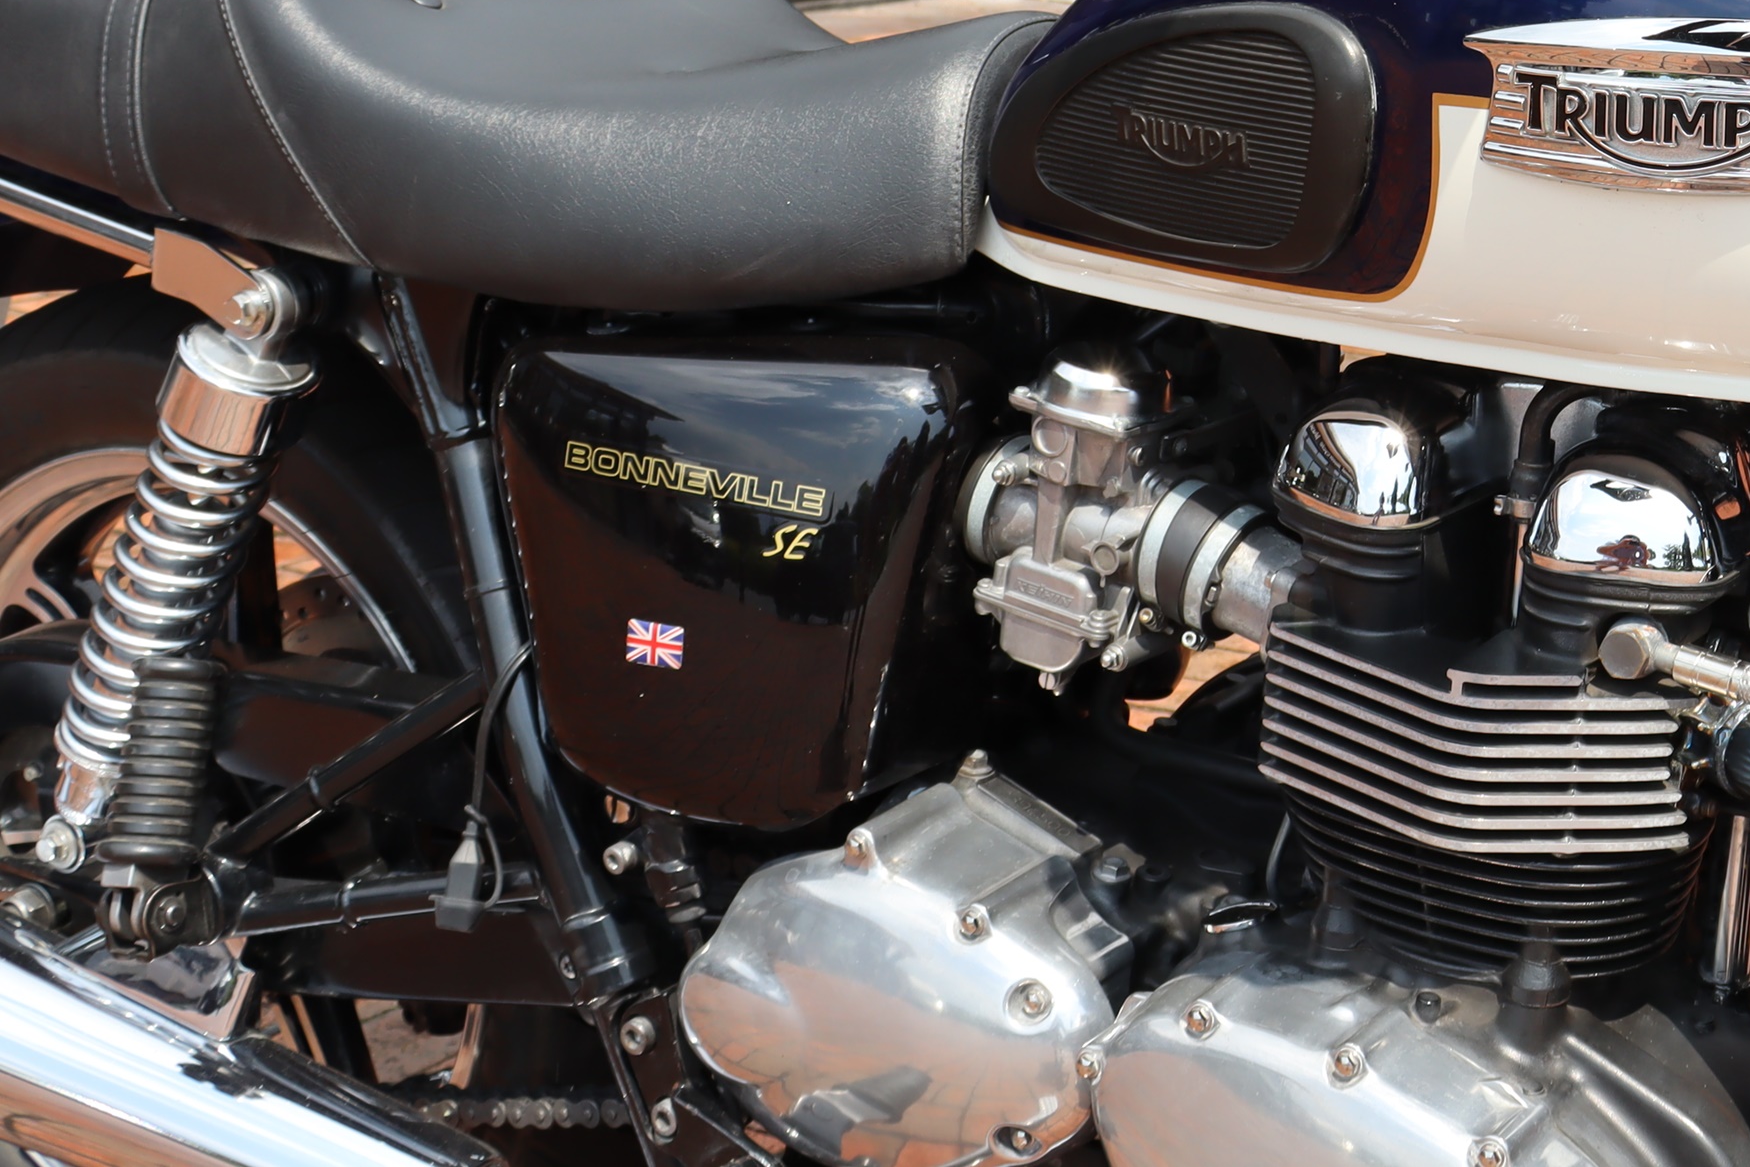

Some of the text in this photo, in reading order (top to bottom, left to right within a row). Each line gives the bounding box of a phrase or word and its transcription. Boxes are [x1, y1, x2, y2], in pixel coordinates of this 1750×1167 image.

[1111, 102, 1250, 168] TRIUMPH
[564, 440, 826, 516] BONNEVILLE
[762, 524, 818, 560] SE
[1016, 577, 1074, 609] KEIHIN
